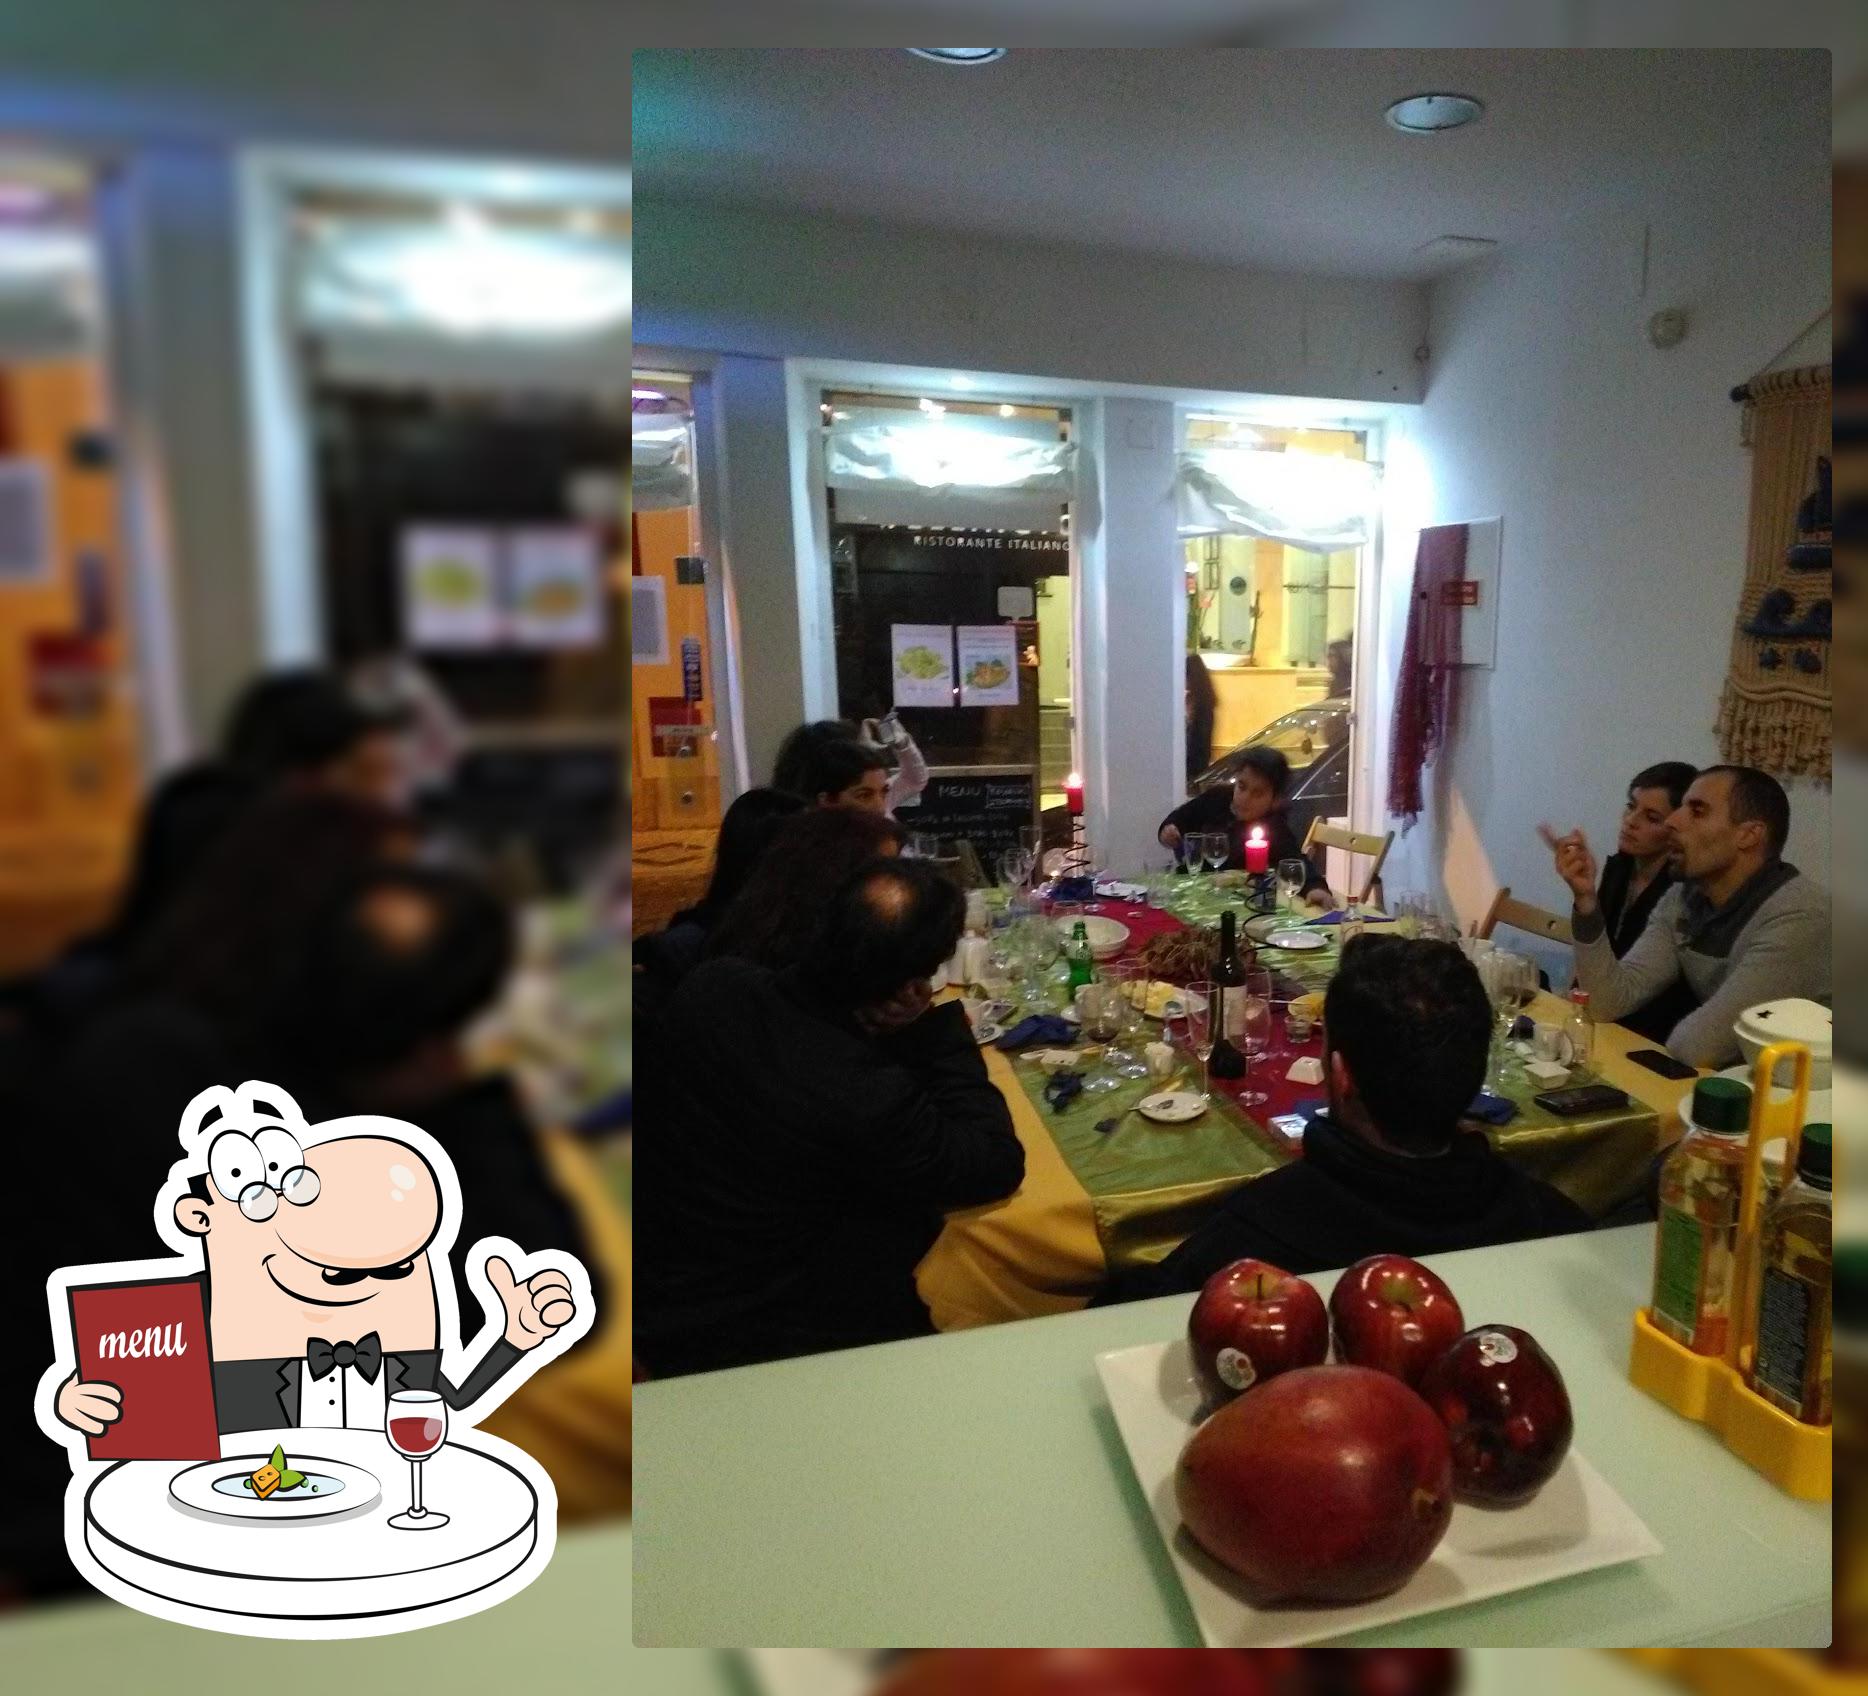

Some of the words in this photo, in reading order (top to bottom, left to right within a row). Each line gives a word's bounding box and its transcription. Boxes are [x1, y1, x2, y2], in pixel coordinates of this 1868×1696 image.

[913, 536, 1001, 549] RISTORANTE
[1008, 539, 1069, 552] ITALIANO
[938, 785, 983, 798] MENU
